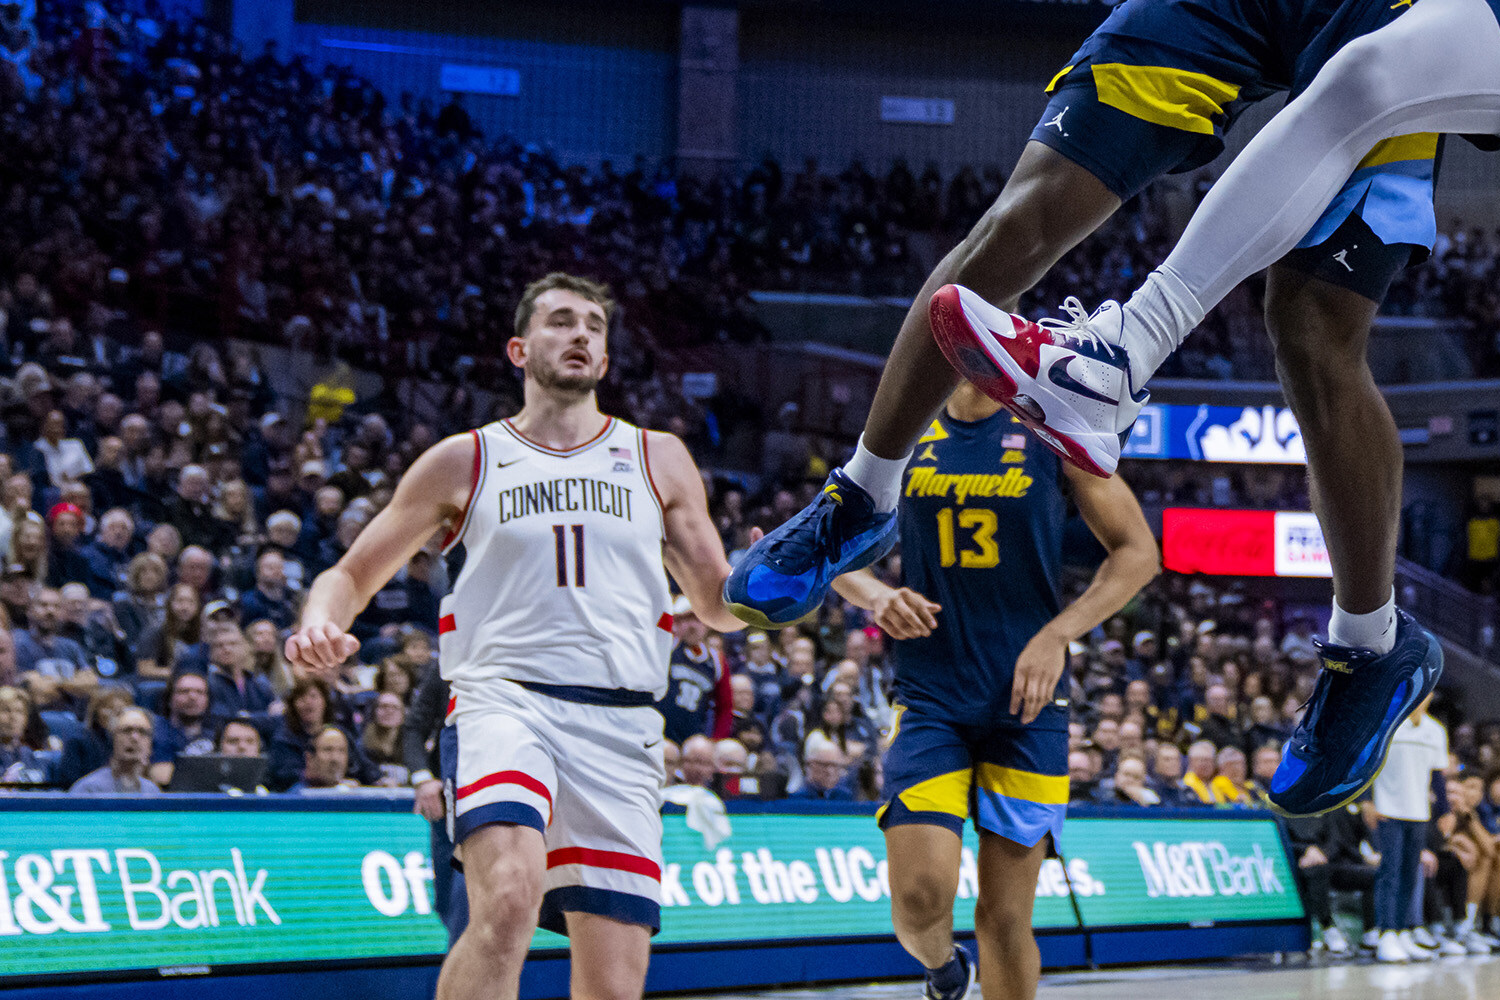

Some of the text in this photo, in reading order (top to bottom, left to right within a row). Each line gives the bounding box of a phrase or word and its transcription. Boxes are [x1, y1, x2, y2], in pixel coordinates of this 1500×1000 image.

[498, 478, 632, 524] CONNECTICUT
[905, 466, 1034, 505] Marquette
[552, 524, 586, 588] 11
[936, 507, 1000, 569] 13
[0, 847, 111, 935] &T
[114, 847, 282, 931] Bank
[692, 848, 741, 907] of
[741, 847, 819, 905] the
[1132, 841, 1216, 898] M&T
[1206, 843, 1286, 896] Bank
